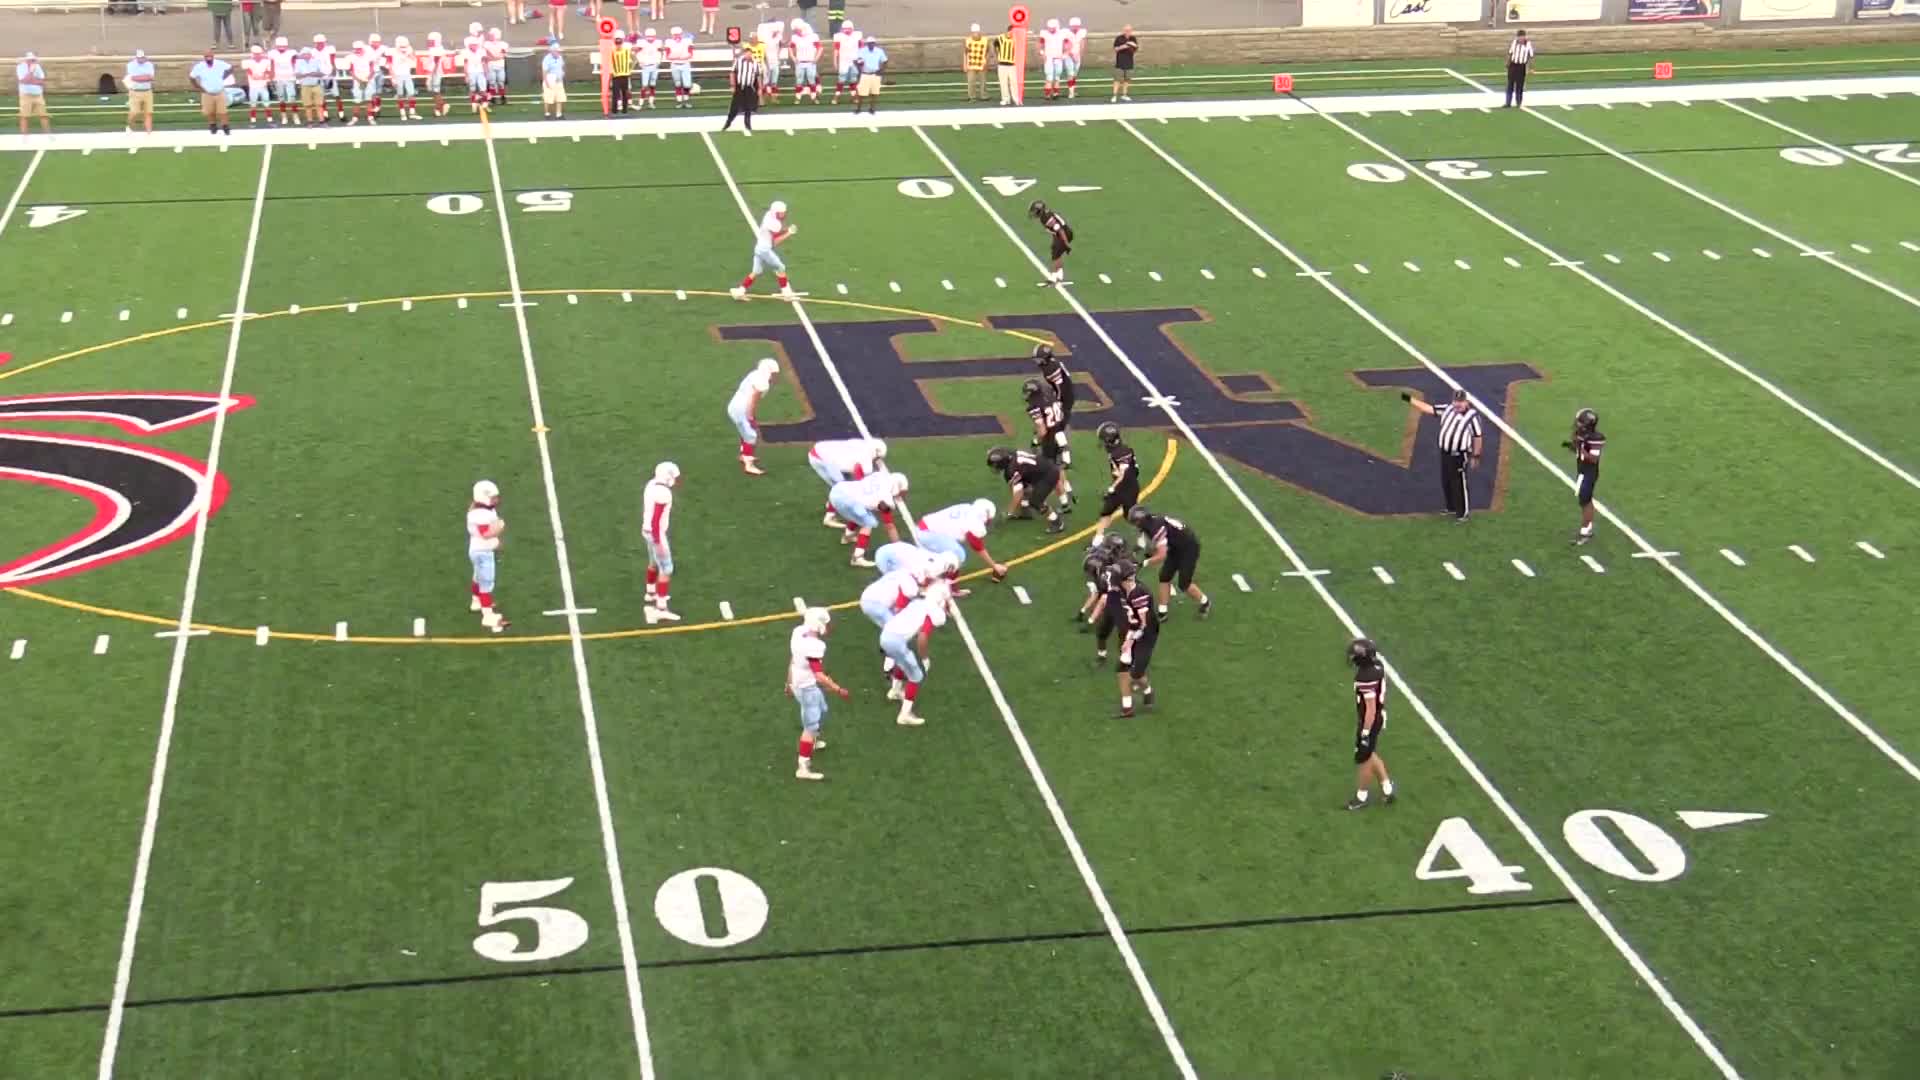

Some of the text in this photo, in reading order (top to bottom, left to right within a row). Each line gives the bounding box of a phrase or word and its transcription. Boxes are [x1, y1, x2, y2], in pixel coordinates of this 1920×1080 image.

[1656, 64, 1670, 76] 20
[1276, 76, 1290, 89] 30
[1346, 160, 1493, 183] 30
[897, 176, 1037, 199] 40
[426, 191, 574, 215] 50
[1415, 809, 1686, 894] 40
[472, 867, 769, 962] 50
